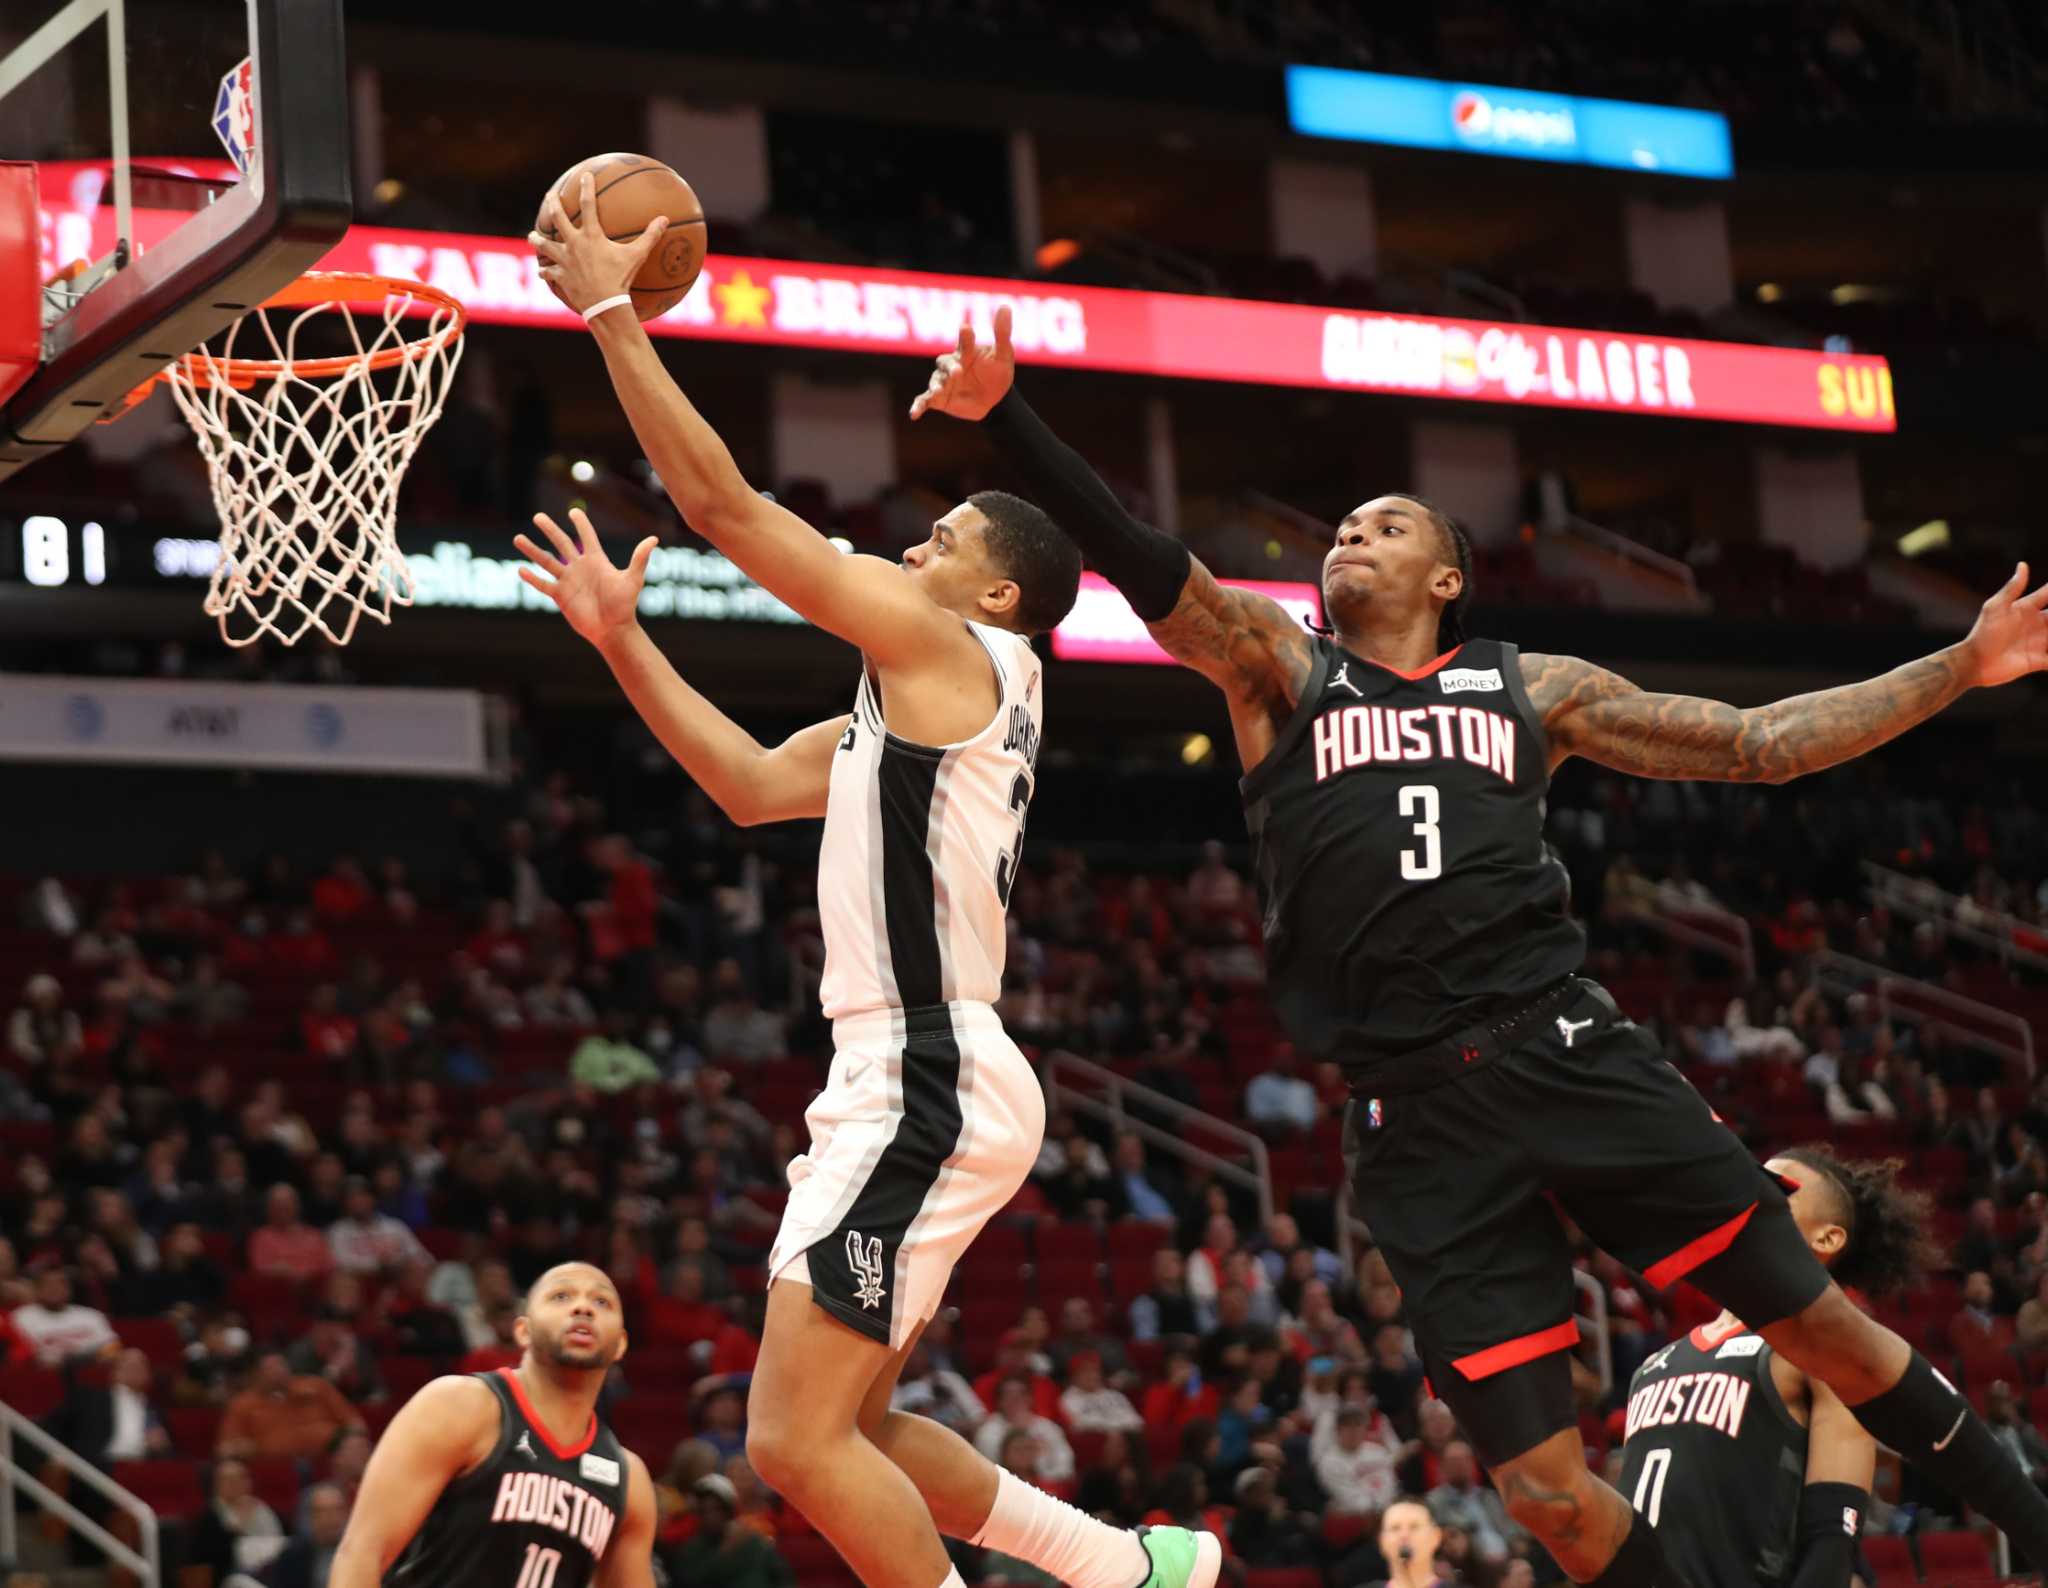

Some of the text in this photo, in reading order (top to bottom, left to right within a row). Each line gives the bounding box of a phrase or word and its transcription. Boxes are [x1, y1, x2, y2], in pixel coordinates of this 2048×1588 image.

[772, 273, 1088, 354] BREWING
[1547, 335, 1696, 409] LAGER
[1443, 678, 1498, 691] MONEY
[1313, 705, 1517, 785] HOUSTON
[1398, 784, 1443, 881] 3
[491, 1471, 616, 1561] HOUSTON
